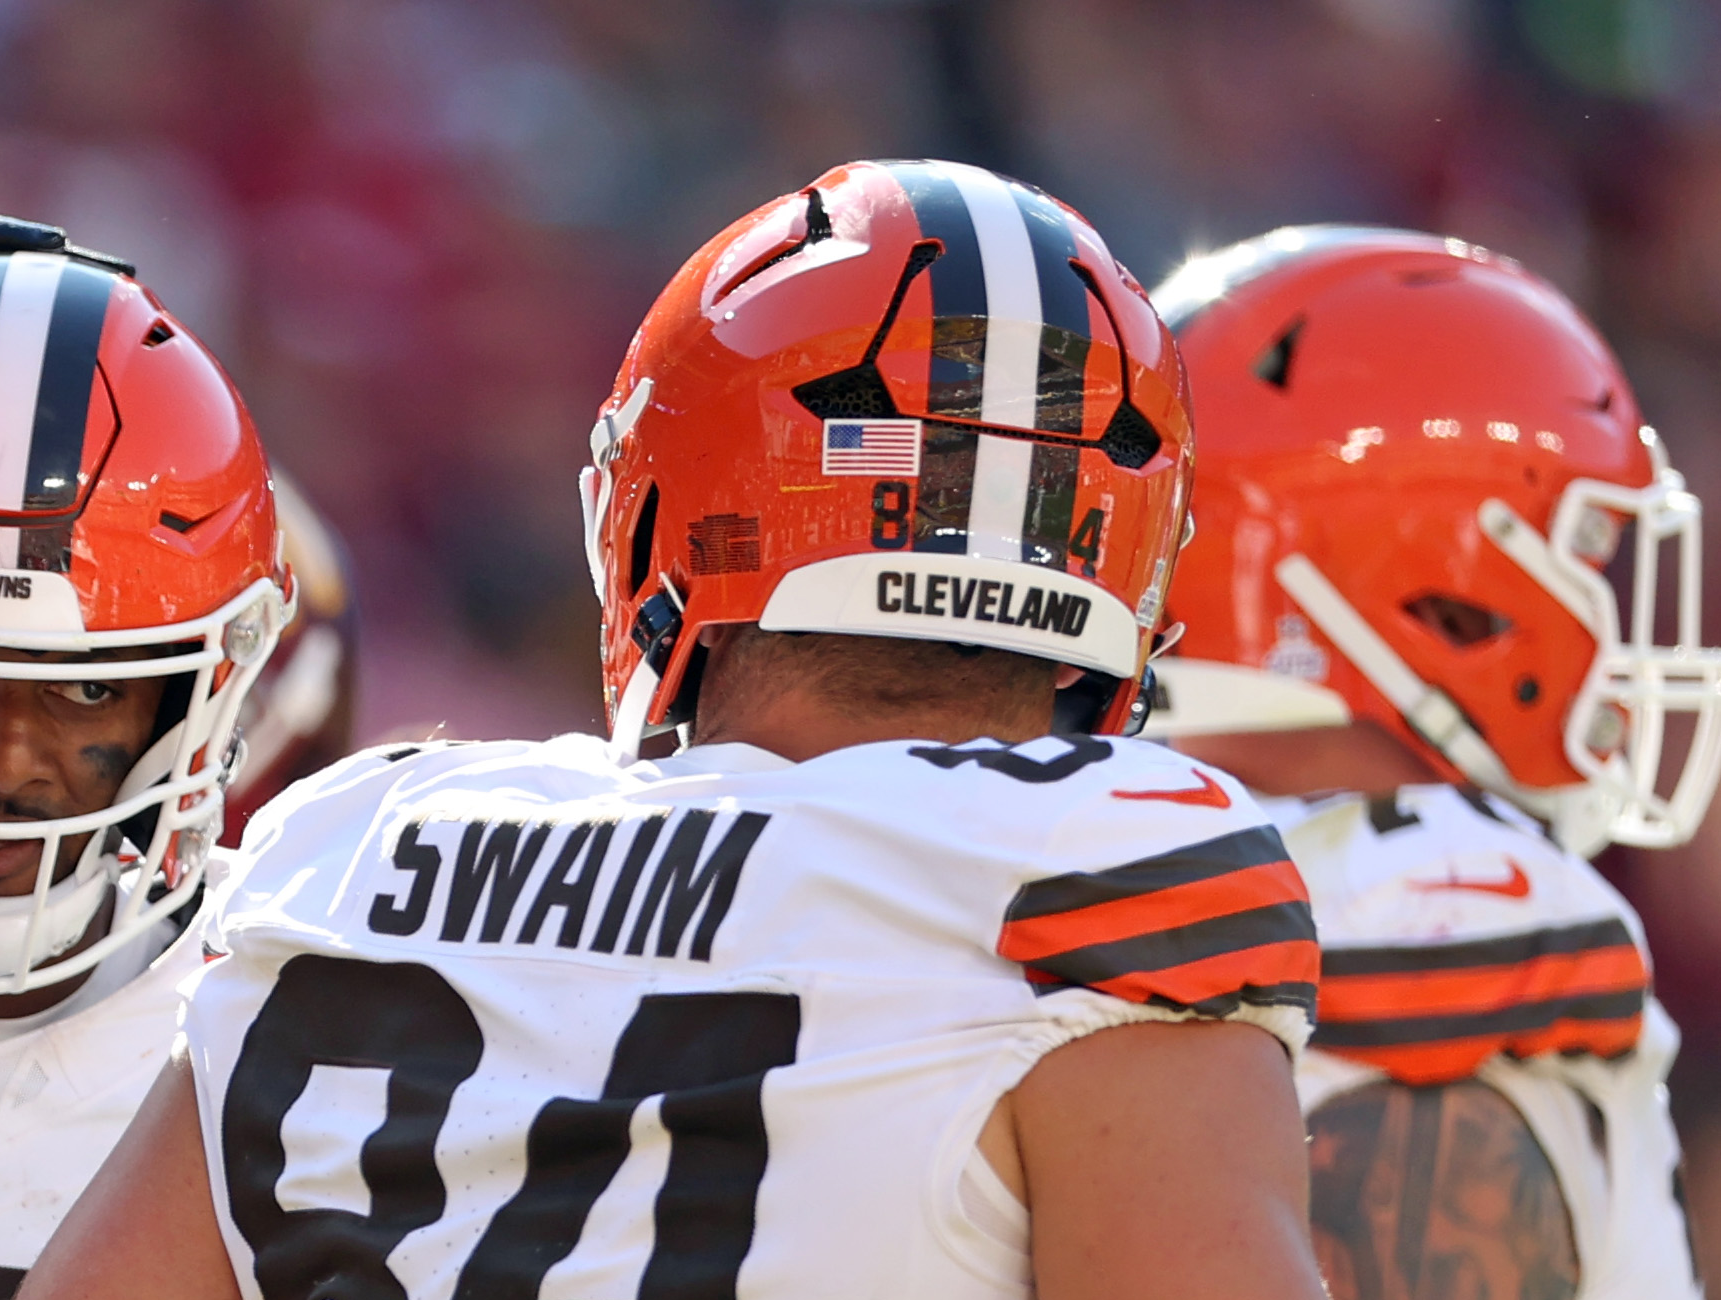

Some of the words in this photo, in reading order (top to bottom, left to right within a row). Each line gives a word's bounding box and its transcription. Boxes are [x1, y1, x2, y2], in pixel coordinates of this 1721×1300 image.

[872, 481, 910, 549] 8
[1069, 507, 1105, 579] 4
[878, 571, 1092, 638] CLEVELAND
[368, 803, 772, 963] SWAIM
